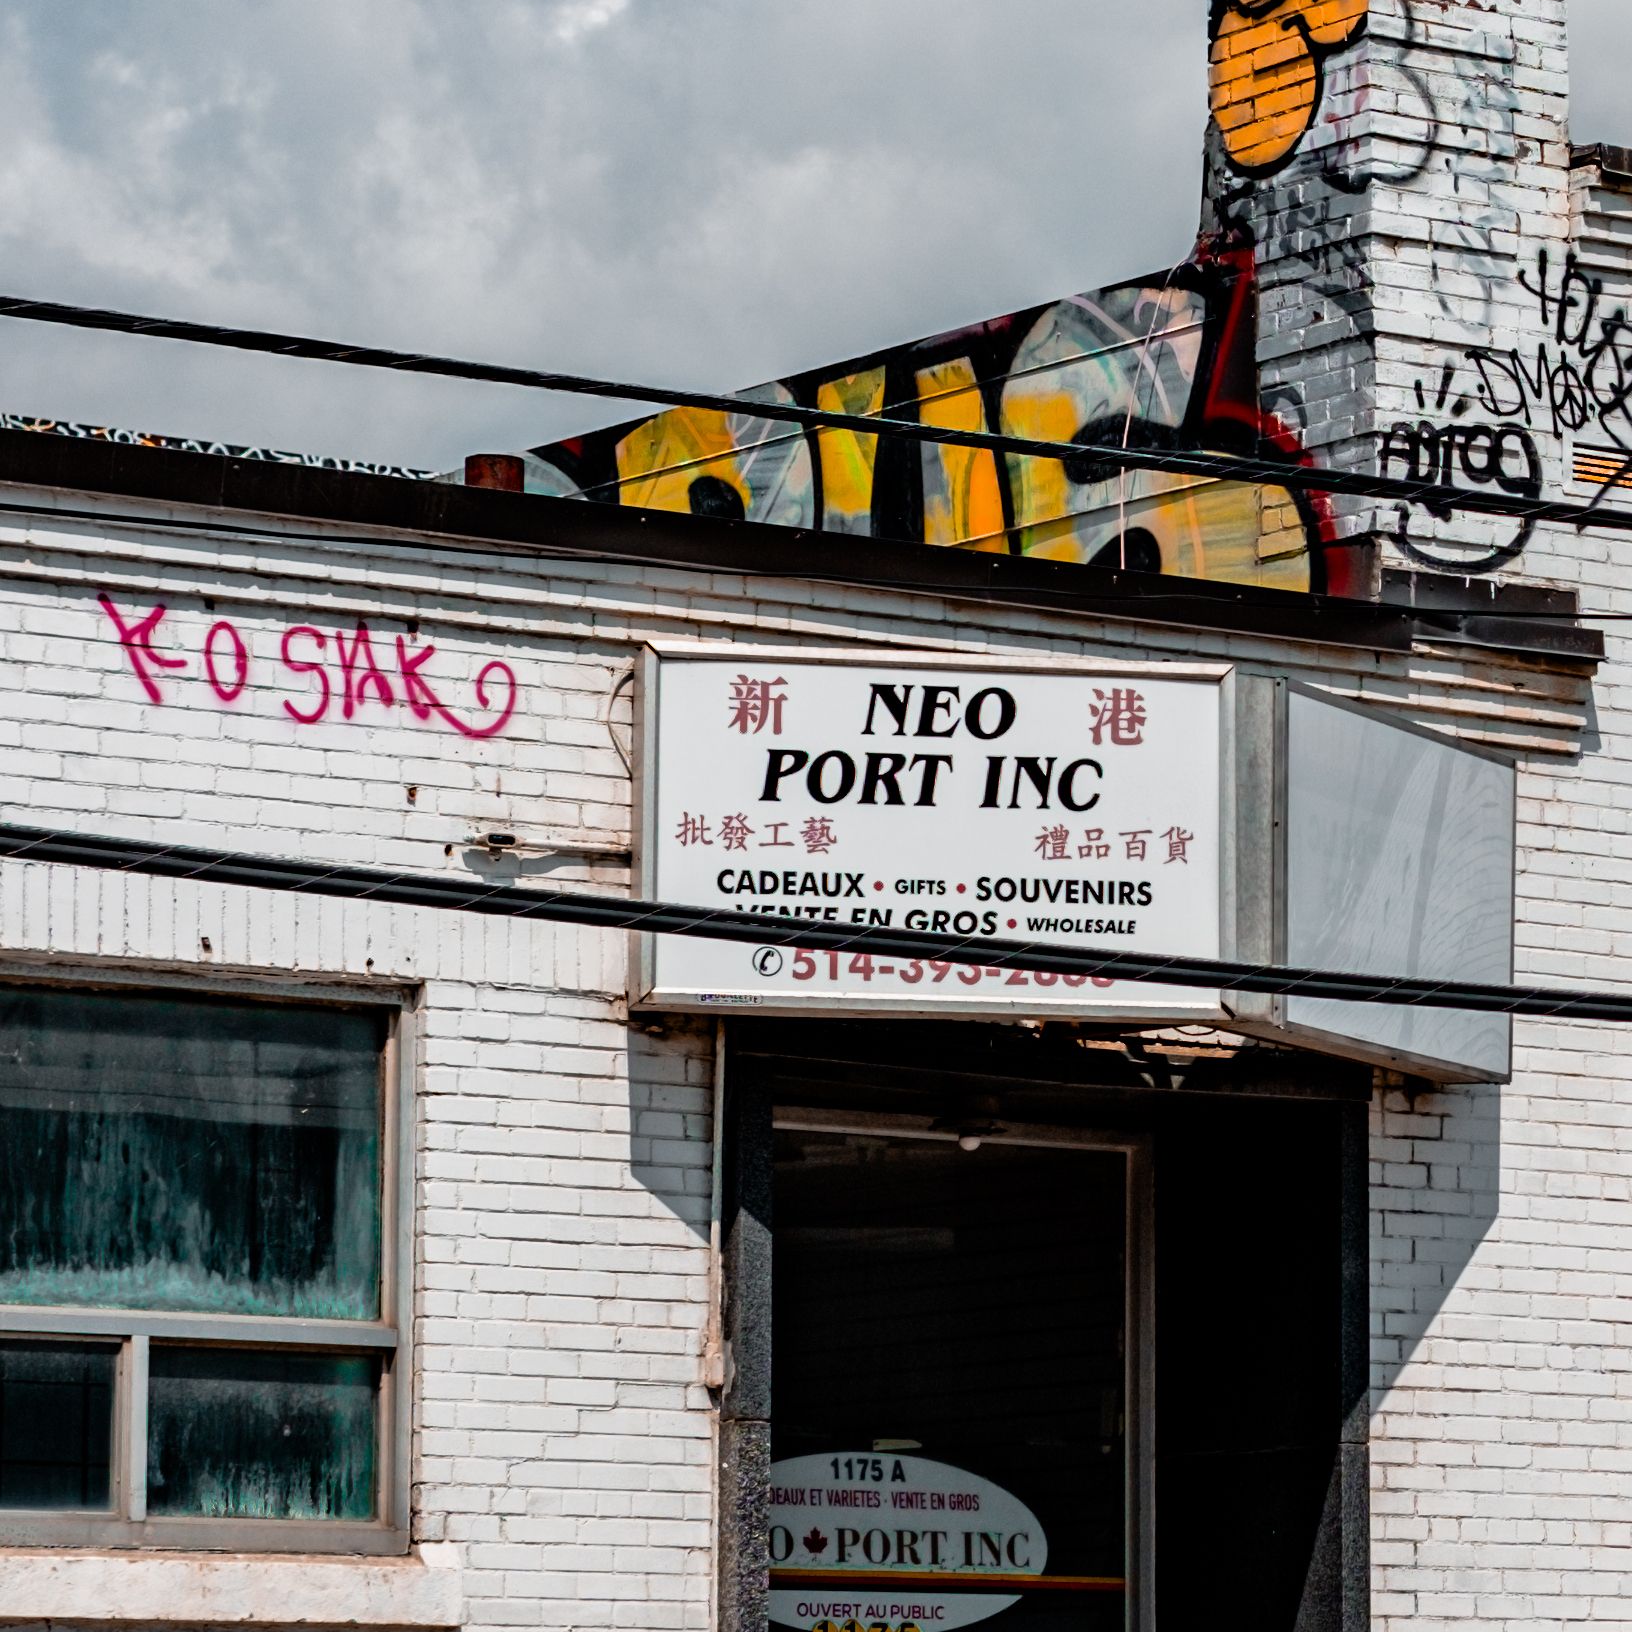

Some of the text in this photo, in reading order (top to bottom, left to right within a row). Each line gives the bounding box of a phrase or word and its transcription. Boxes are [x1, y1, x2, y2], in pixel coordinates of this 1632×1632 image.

[97, 593, 517, 740] KOSAK
[727, 674, 789, 735] 新
[861, 682, 1017, 740] NEO
[1088, 688, 1148, 746] 港
[758, 748, 1104, 812] PORT INC
[675, 811, 838, 855] 批發工藝
[1033, 824, 1194, 865] 禮品百貨
[716, 869, 1153, 907] CADEAUX GIFTS SOUVENIRS
[904, 909, 999, 936] GROS
[1026, 916, 1137, 935] WHOLESALE
[830, 1457, 906, 1483] 1175 A
[809, 1488, 823, 1507] ET
[826, 1489, 881, 1508] VARIETES
[891, 1491, 927, 1510] VENTE
[930, 1493, 945, 1510] EN
[949, 1493, 980, 1512] GROS
[834, 1527, 948, 1566] PORT
[961, 1530, 1031, 1569] INC
[796, 1601, 945, 1621] OUVERT AU PUBLIC
